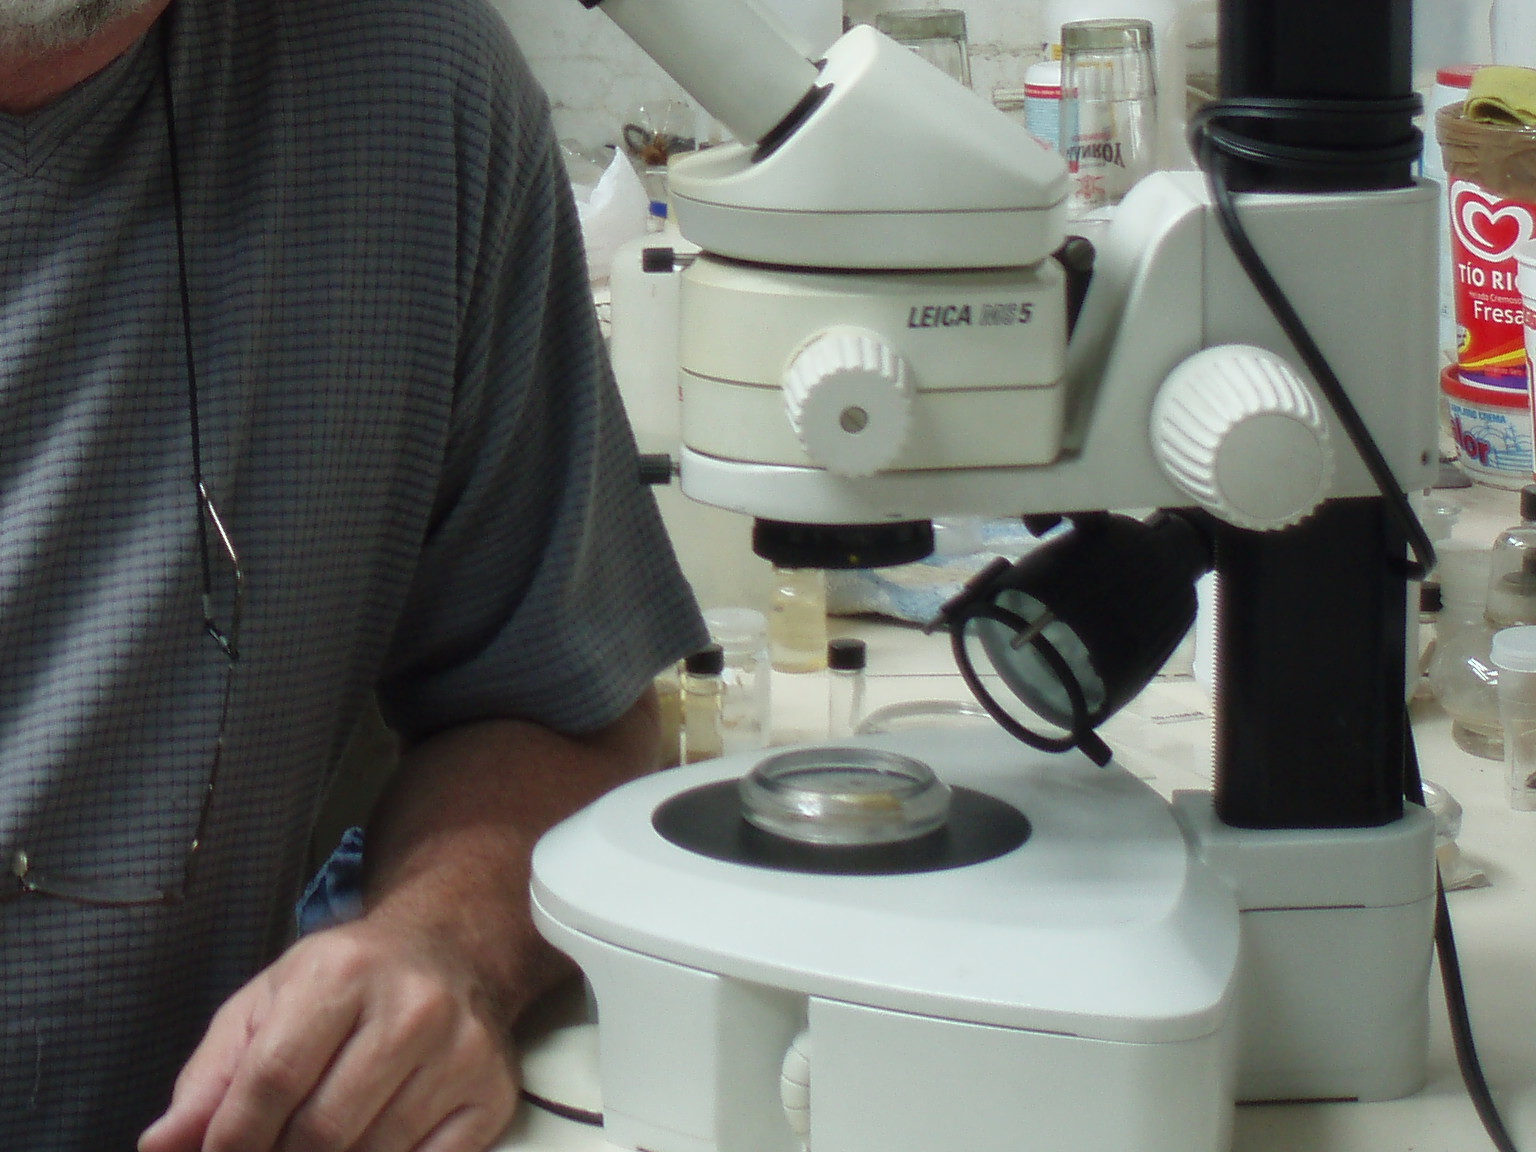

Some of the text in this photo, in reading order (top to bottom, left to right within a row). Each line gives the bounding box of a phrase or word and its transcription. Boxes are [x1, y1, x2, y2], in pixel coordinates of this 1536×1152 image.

[1458, 261, 1516, 291] TÍO RI
[907, 304, 972, 328] LEICA
[1473, 300, 1524, 325] Fresa
